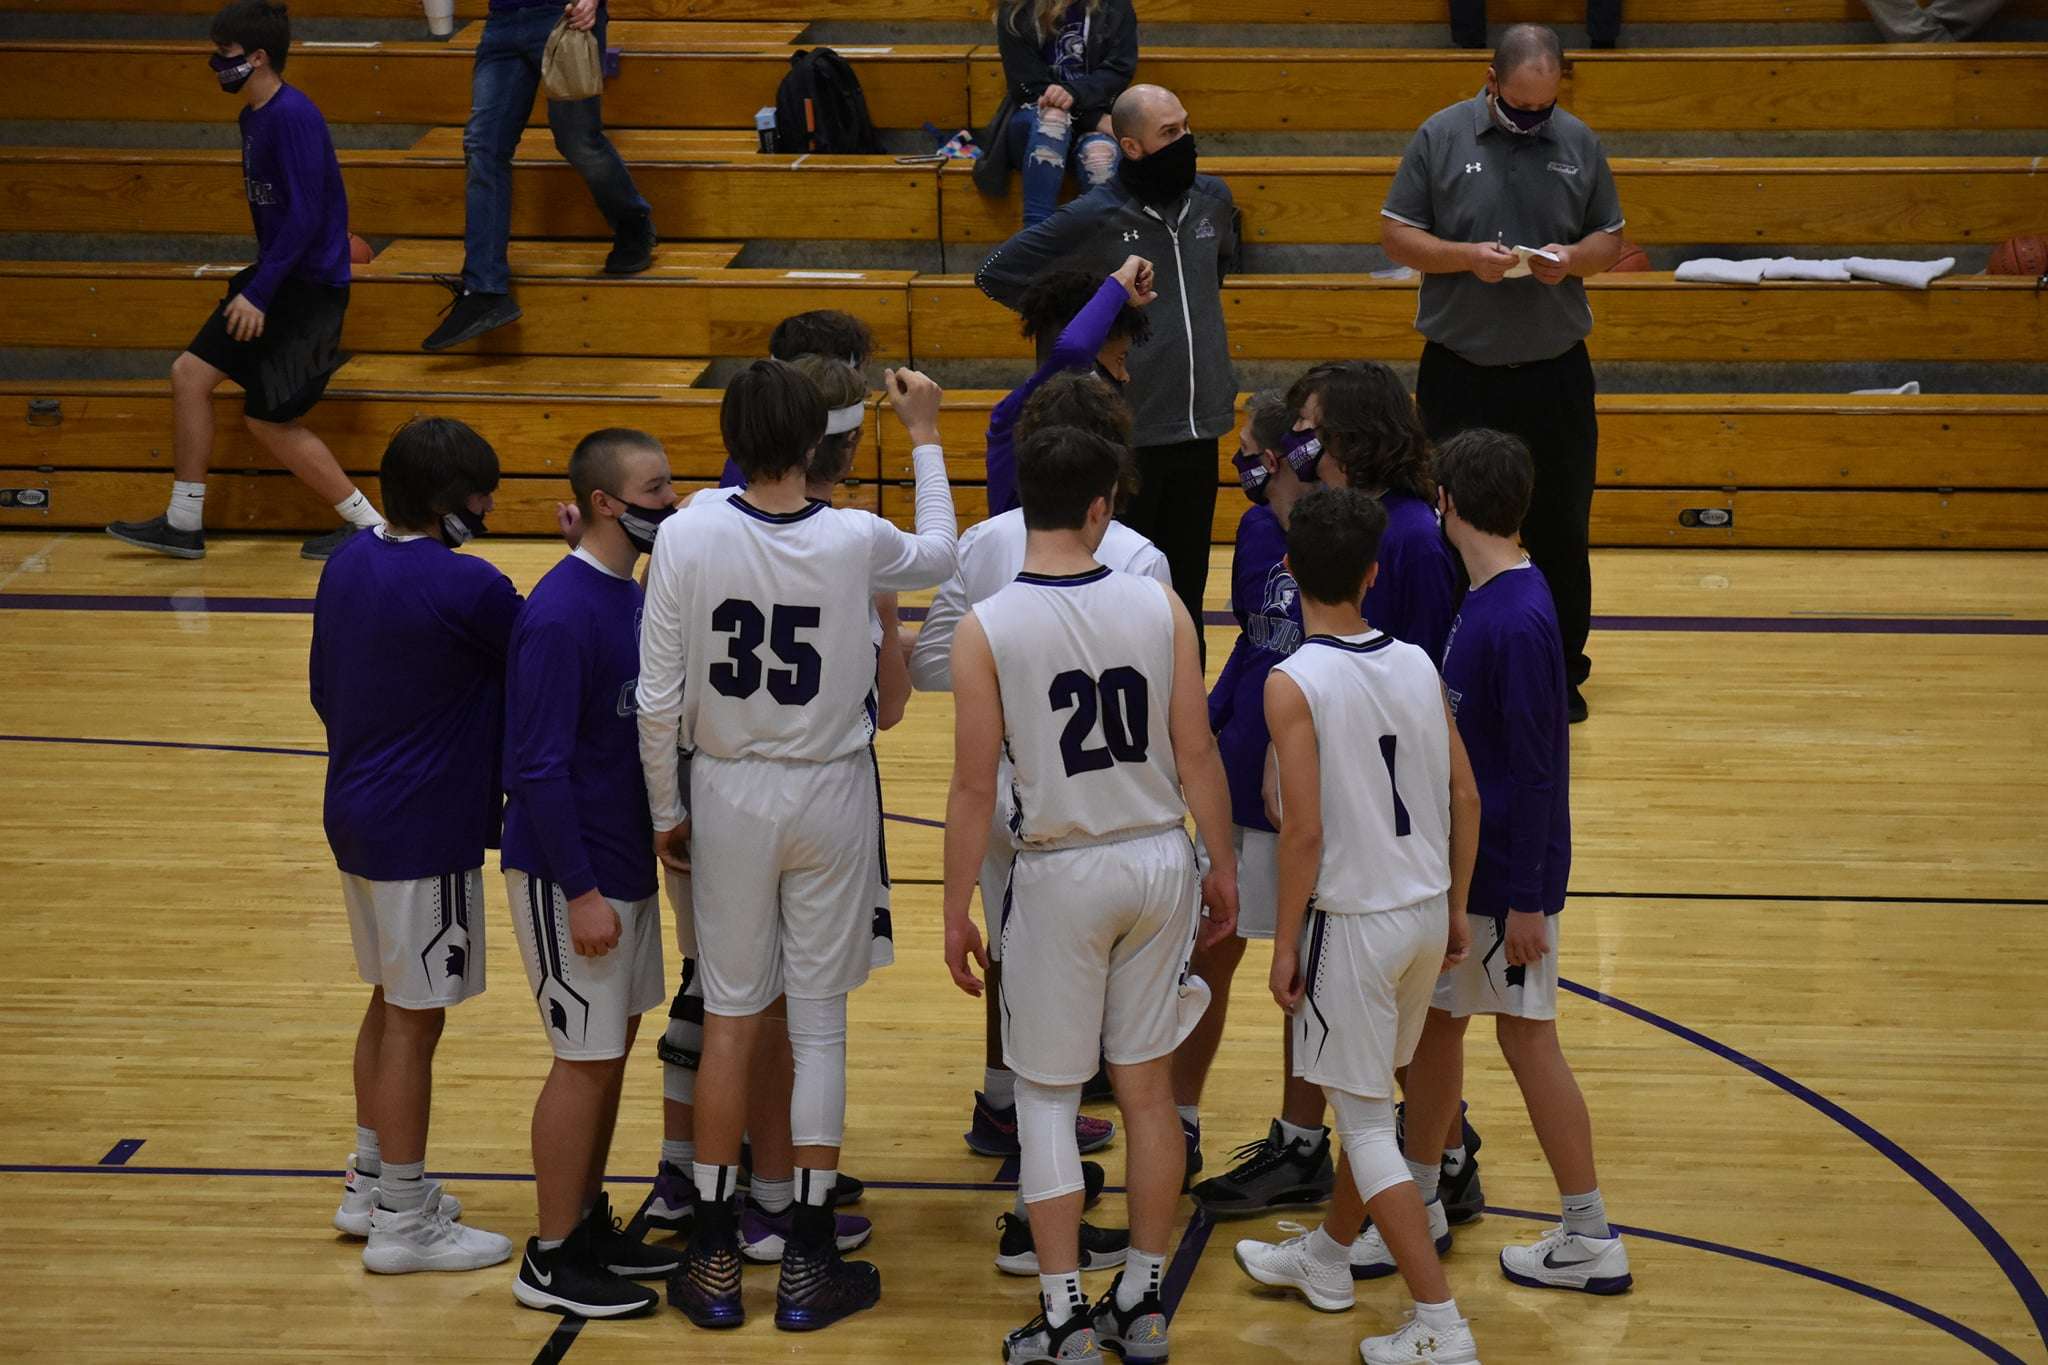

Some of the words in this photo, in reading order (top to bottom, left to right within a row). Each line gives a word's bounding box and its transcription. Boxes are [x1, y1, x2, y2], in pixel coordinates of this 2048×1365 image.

[709, 598, 822, 706] 35
[1048, 666, 1148, 777] 20
[1380, 735, 1411, 836] 1
